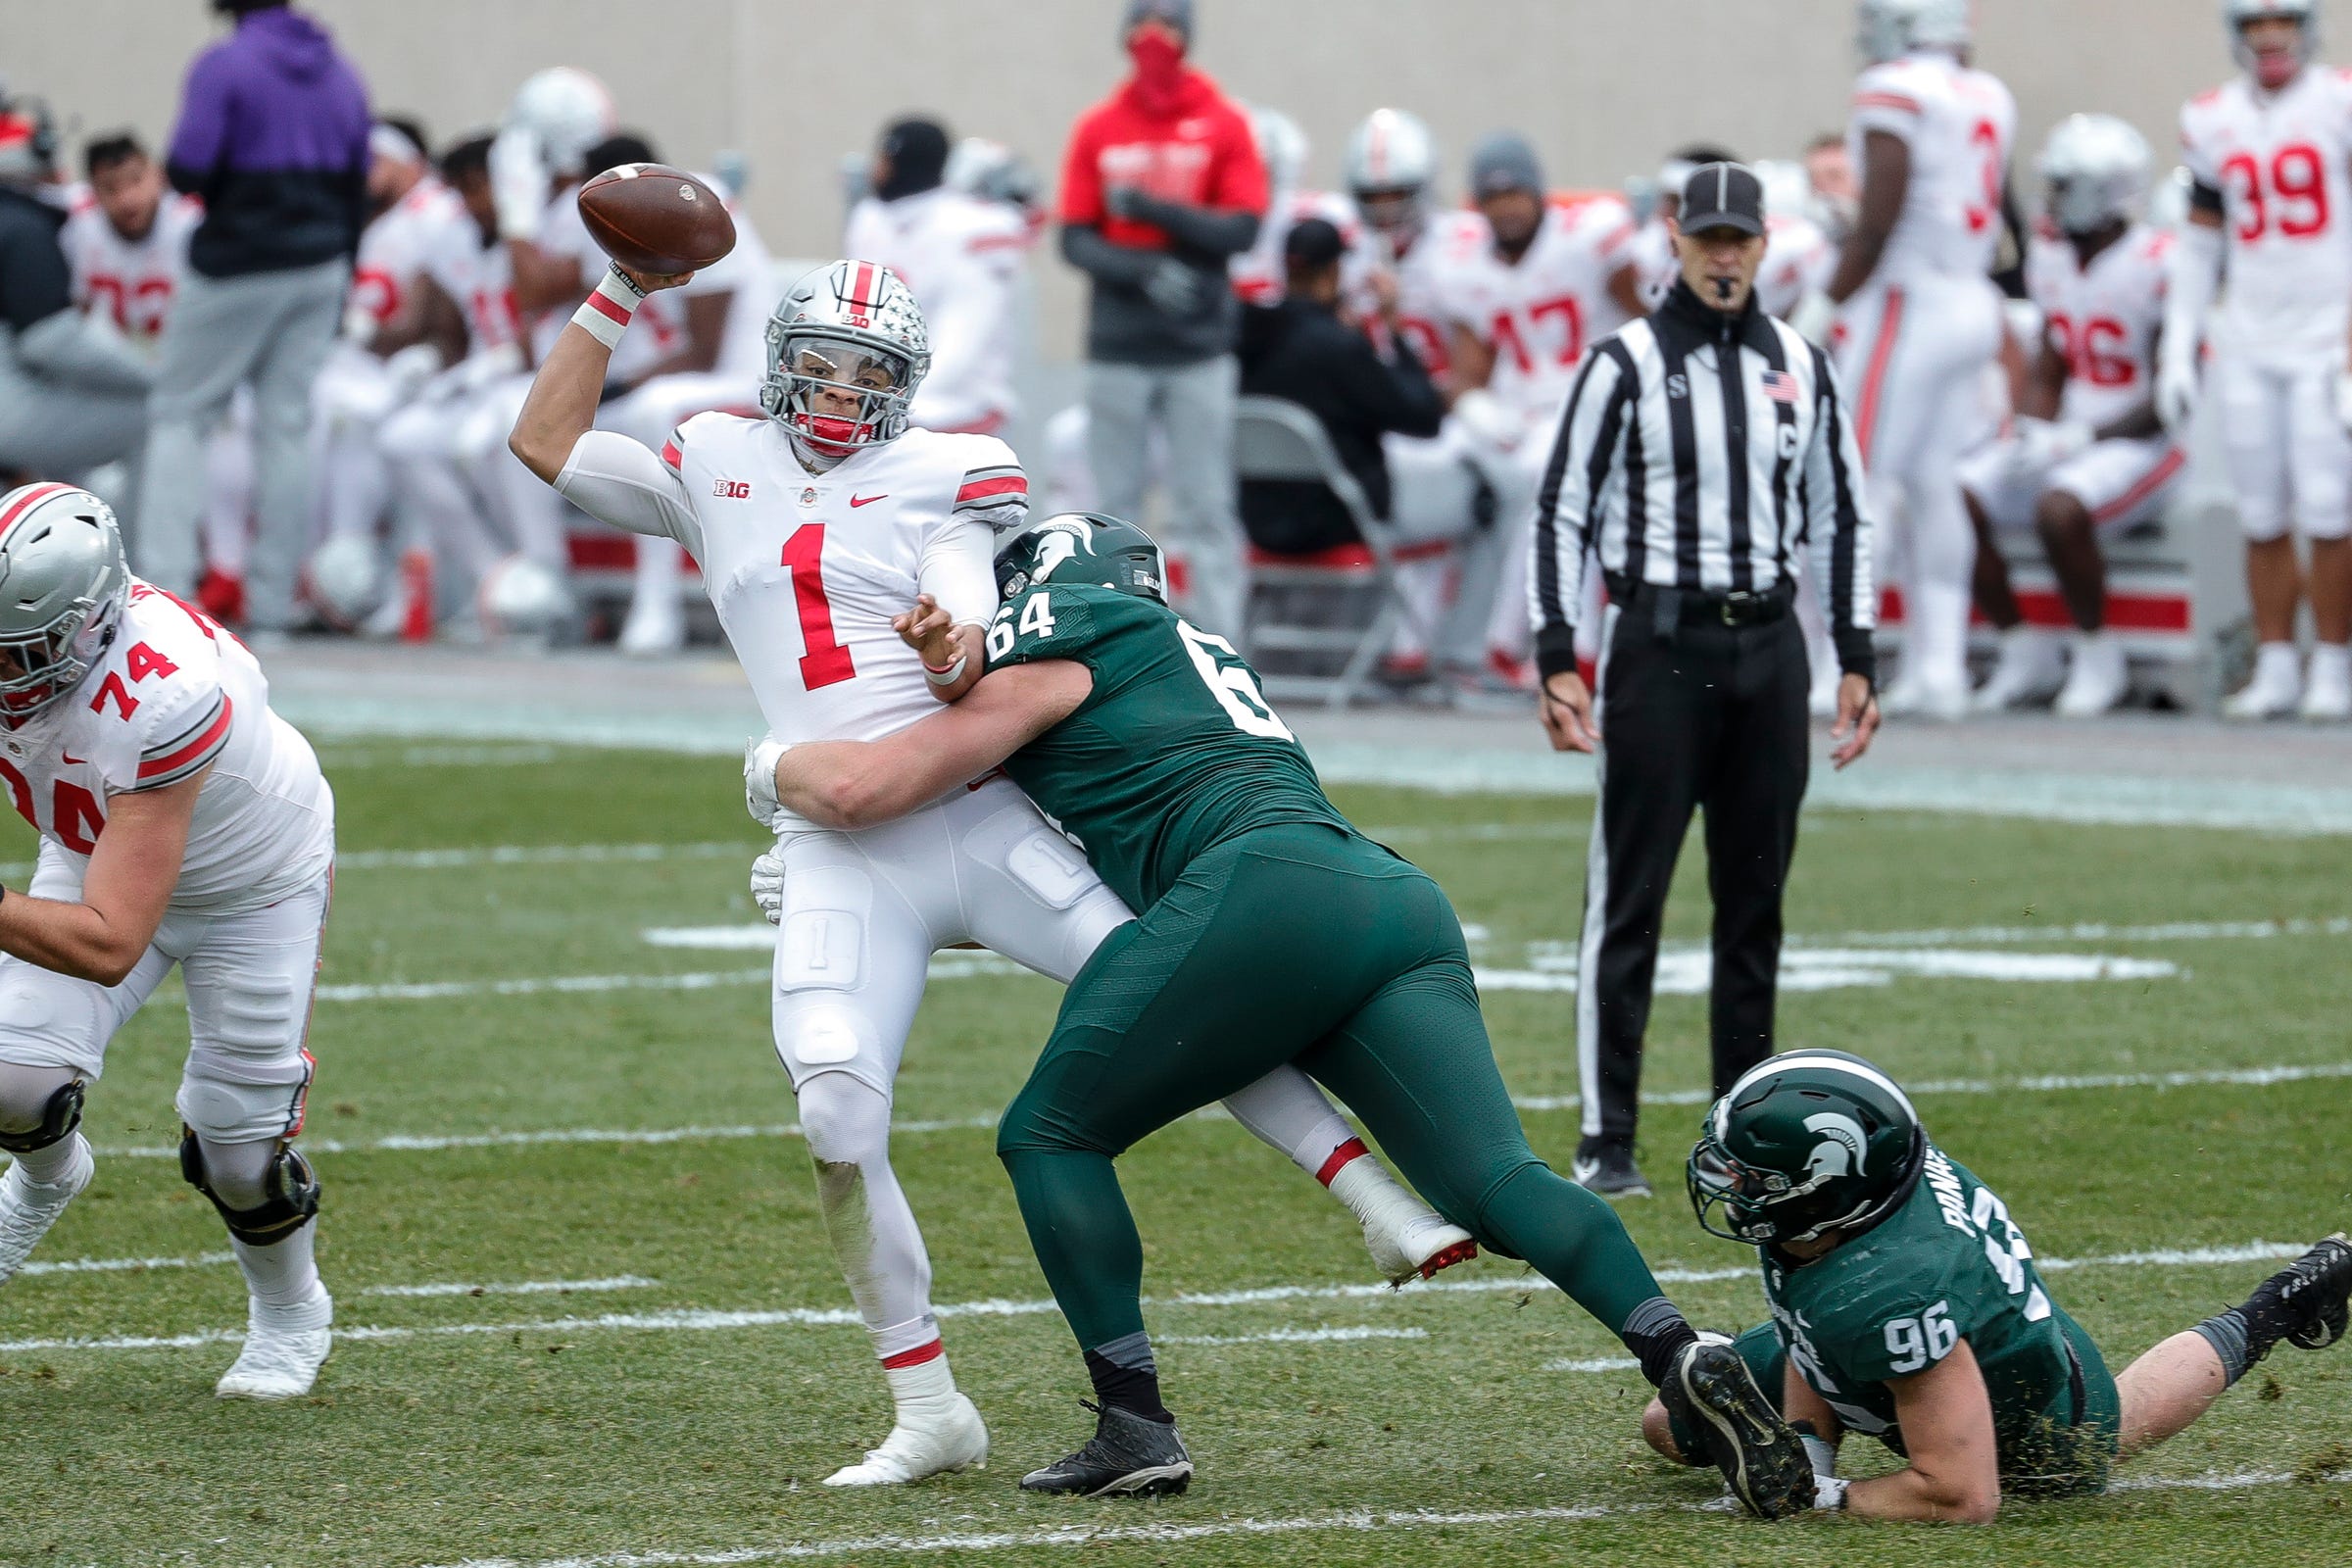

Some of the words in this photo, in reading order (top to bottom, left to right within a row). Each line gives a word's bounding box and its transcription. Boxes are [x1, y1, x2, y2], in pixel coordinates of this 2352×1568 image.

[2218, 144, 2328, 243] 39
[781, 523, 857, 692] 1
[985, 592, 1055, 662] 64
[90, 641, 180, 722] 74
[1884, 1299, 1959, 1373] 96
